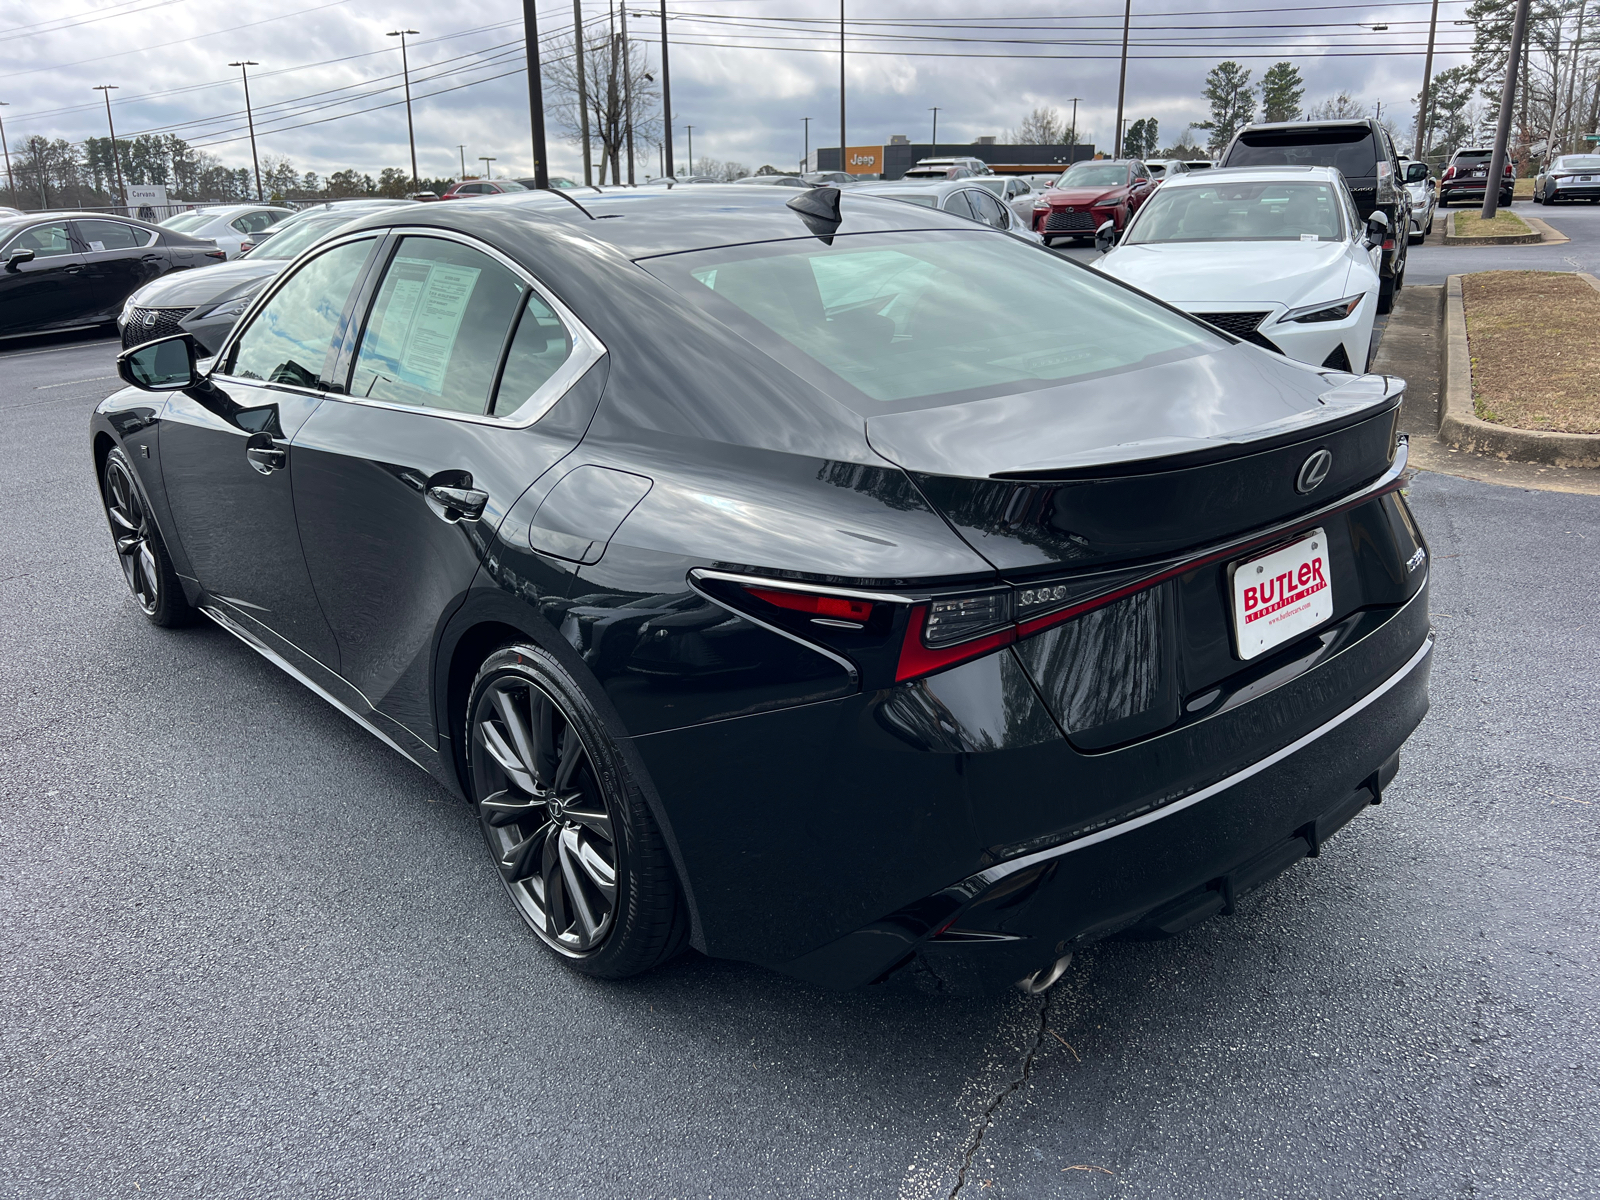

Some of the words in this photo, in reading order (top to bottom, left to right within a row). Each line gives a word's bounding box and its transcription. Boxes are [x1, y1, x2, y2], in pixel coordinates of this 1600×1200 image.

[851, 153, 875, 167] Jeep
[132, 190, 156, 198] Carvana
[1246, 596, 1297, 623] AUTOMOTIVE
[1303, 581, 1326, 596] GROUP
[1268, 602, 1311, 626] www.butlercars.com
